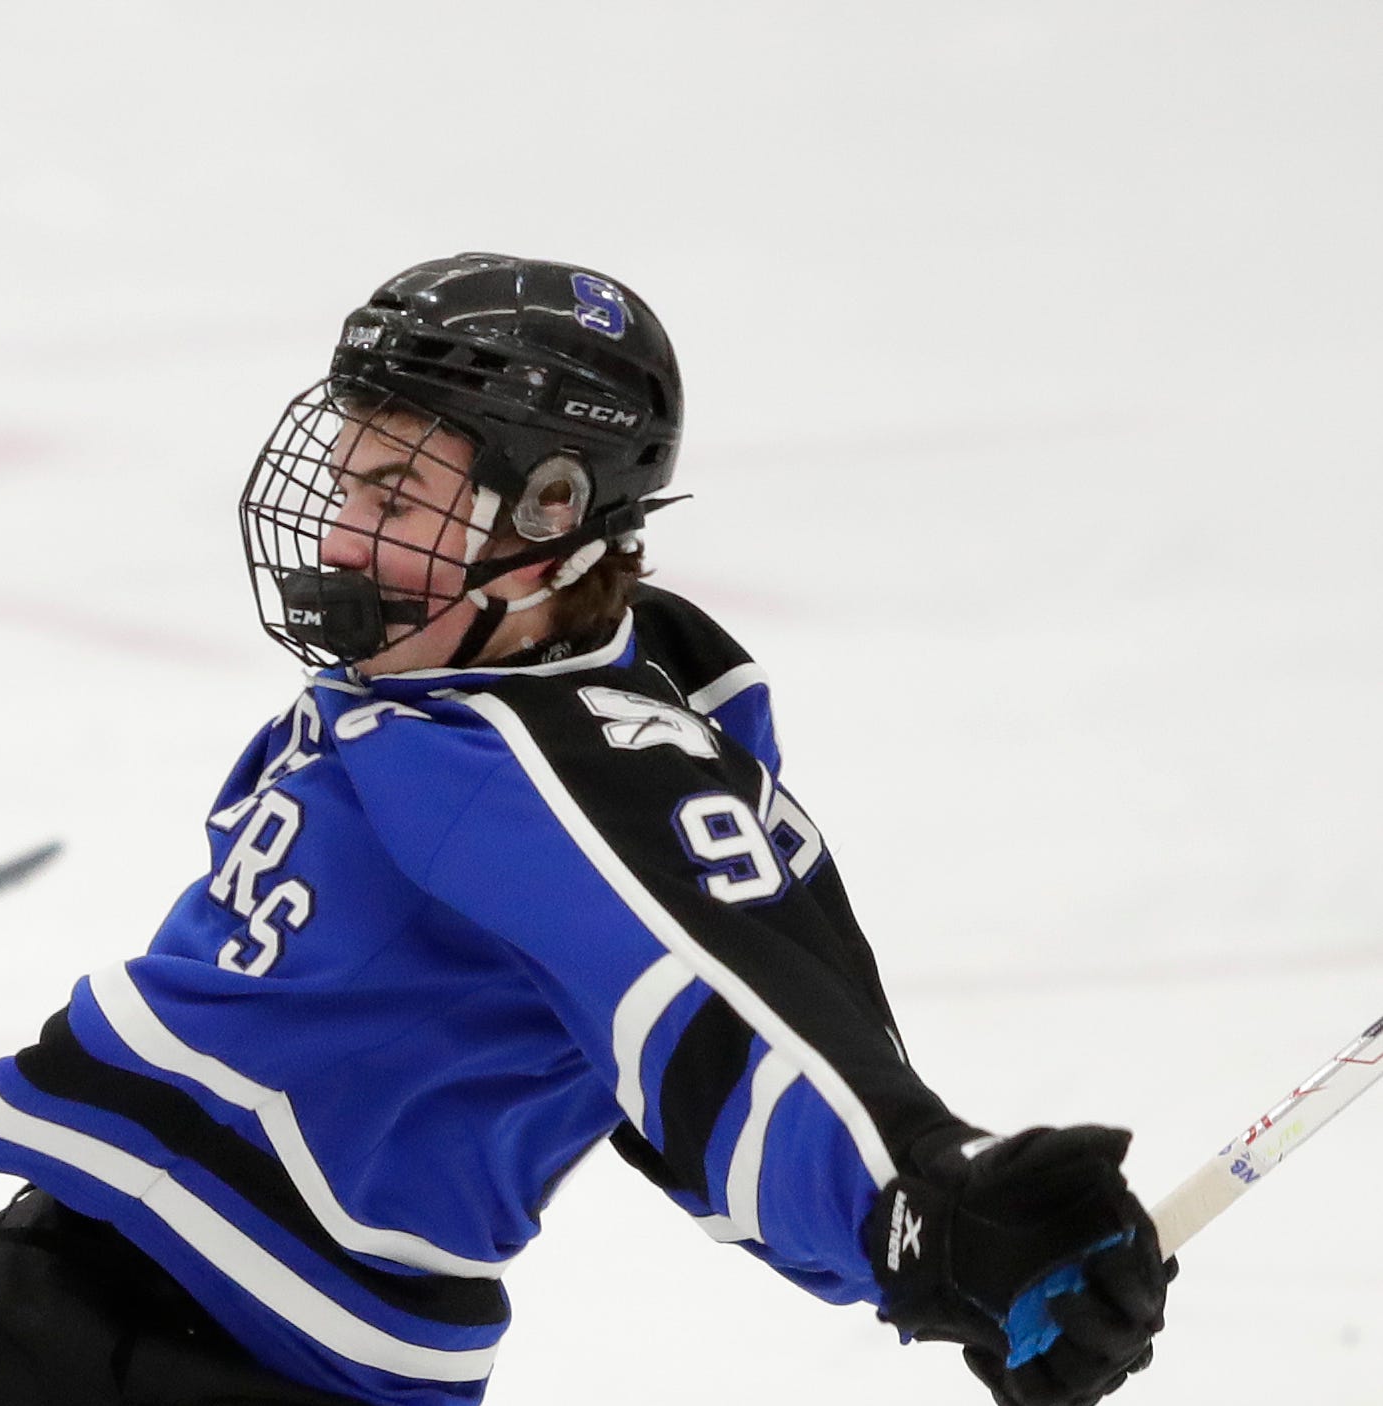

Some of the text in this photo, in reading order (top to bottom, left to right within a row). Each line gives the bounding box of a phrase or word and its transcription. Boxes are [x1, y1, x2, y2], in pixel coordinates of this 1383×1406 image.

[569, 272, 625, 341] S
[563, 401, 637, 427] CCM
[288, 608, 323, 626] CM
